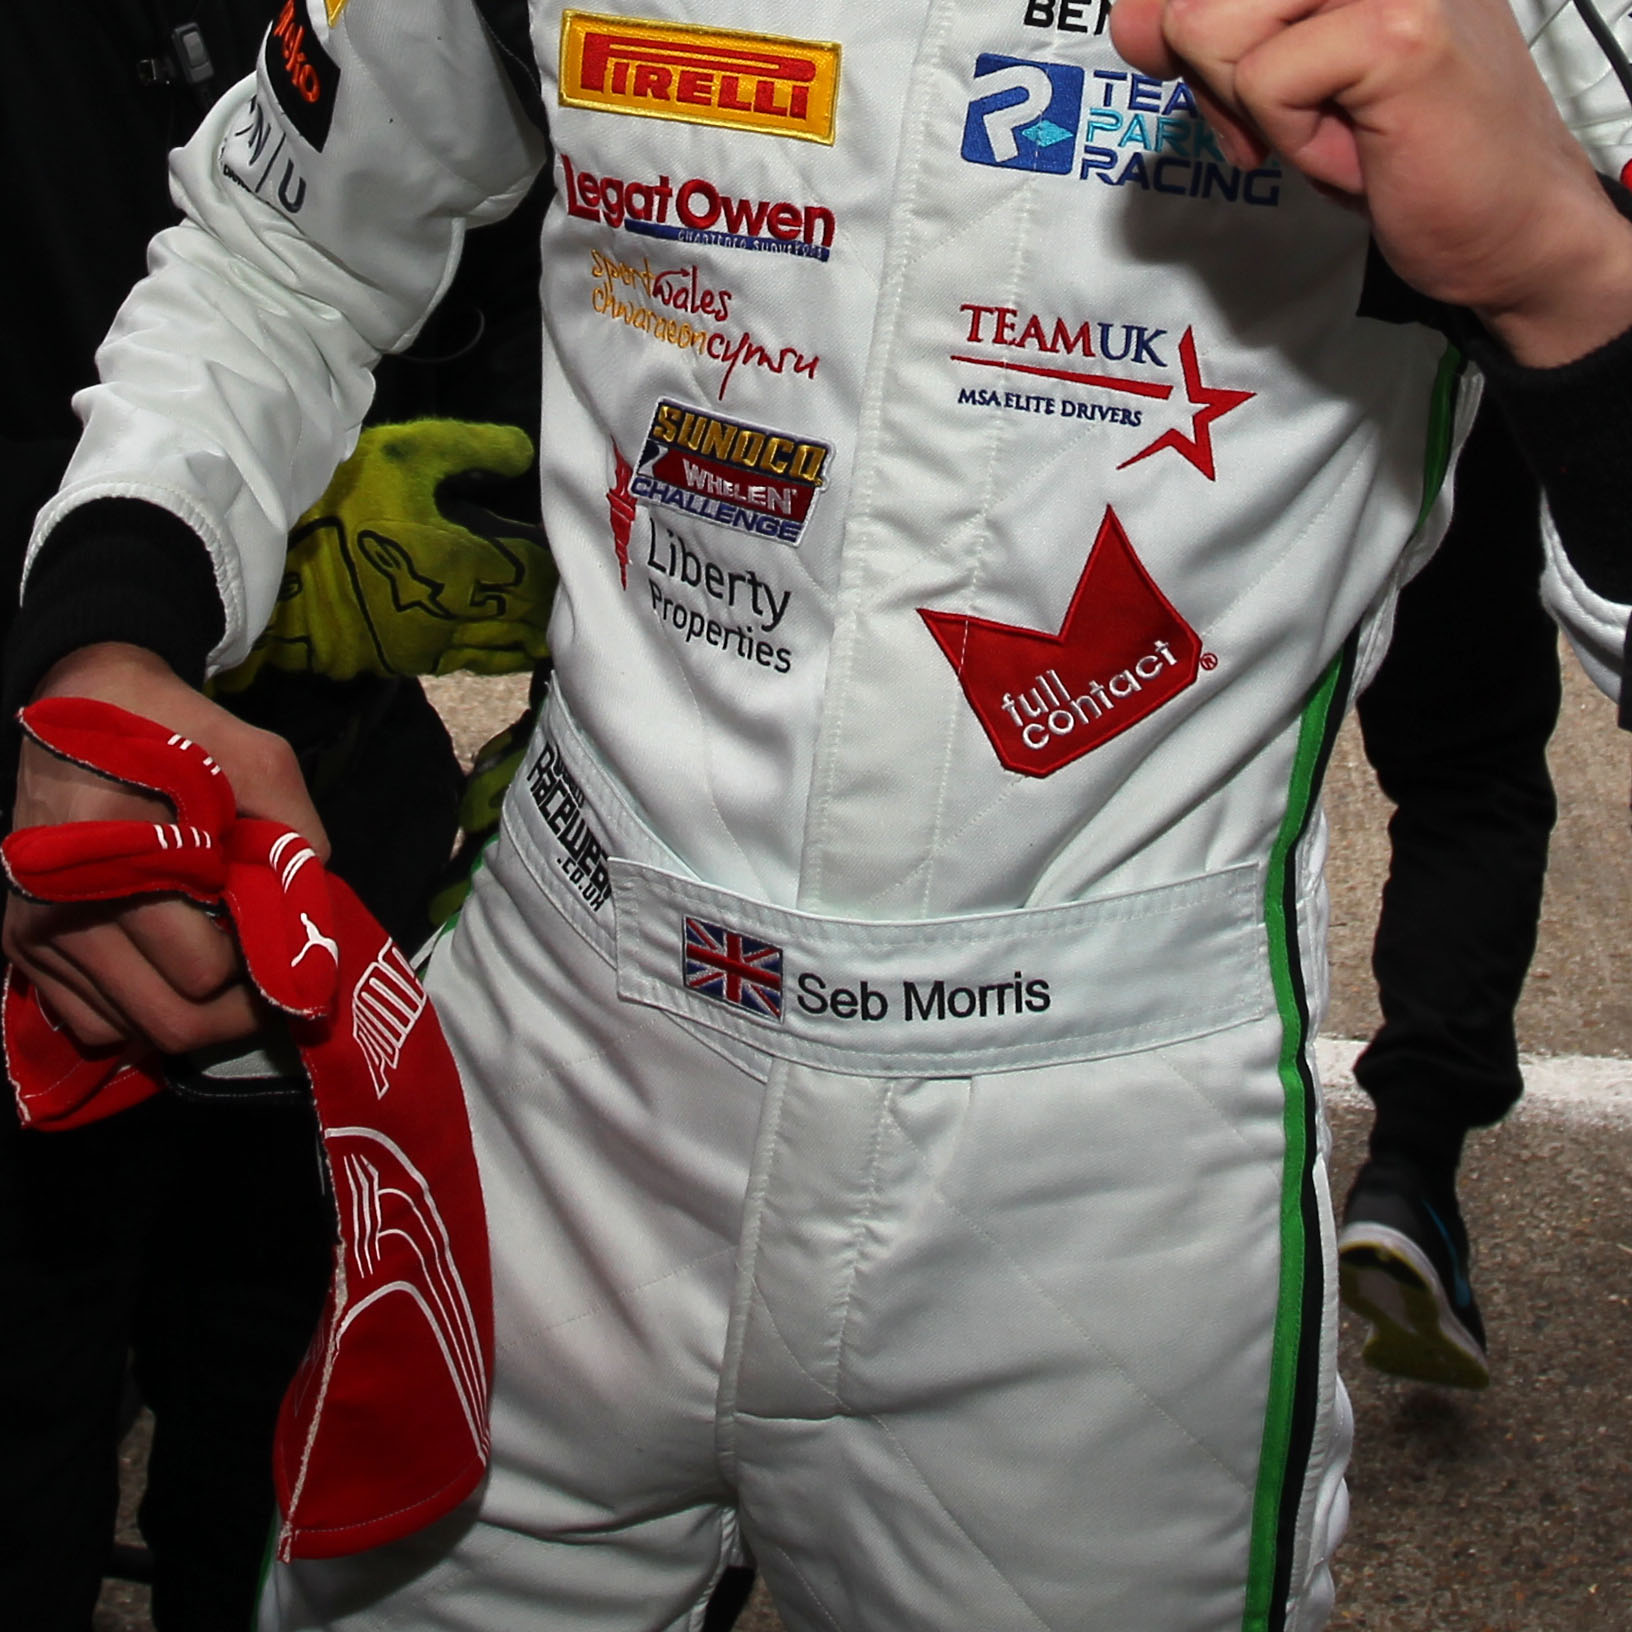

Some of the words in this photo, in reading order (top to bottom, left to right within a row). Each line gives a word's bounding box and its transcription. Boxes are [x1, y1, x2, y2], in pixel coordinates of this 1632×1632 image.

[580, 32, 818, 121] PIRELLI
[1094, 70, 1197, 118] TEA
[1080, 146, 1283, 207] RACING
[958, 388, 1001, 407] MSA
[1004, 391, 1055, 415] ELITE
[1060, 401, 1142, 427] DRIVERS
[652, 404, 828, 484] SUNOCO
[630, 476, 805, 544] CHALLENGE
[682, 457, 793, 515] WHELEN
[647, 517, 791, 633] Liberty
[648, 578, 792, 674] Properties
[1001, 669, 1071, 726] full
[1022, 639, 1178, 750] contact
[797, 971, 888, 1022] Seb
[904, 971, 1052, 1023] Morris
